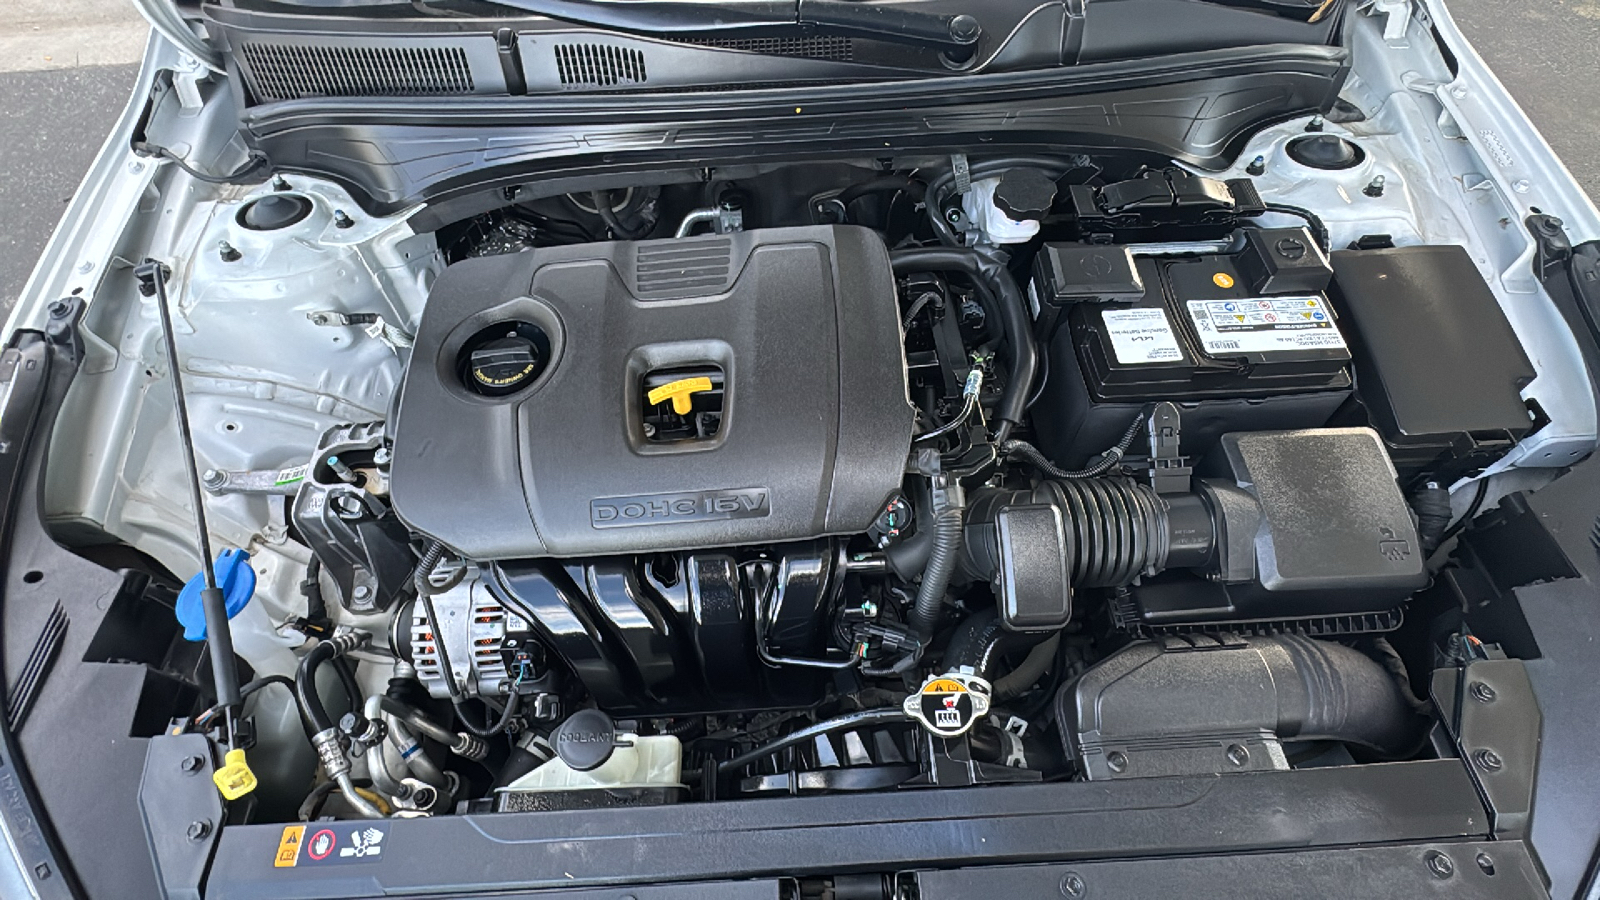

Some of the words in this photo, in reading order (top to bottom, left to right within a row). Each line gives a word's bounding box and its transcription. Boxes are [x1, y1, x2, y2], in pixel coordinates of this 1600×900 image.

[593, 499, 697, 523] DOHC
[703, 493, 766, 514] 16V
[559, 732, 613, 744] COOLANT
